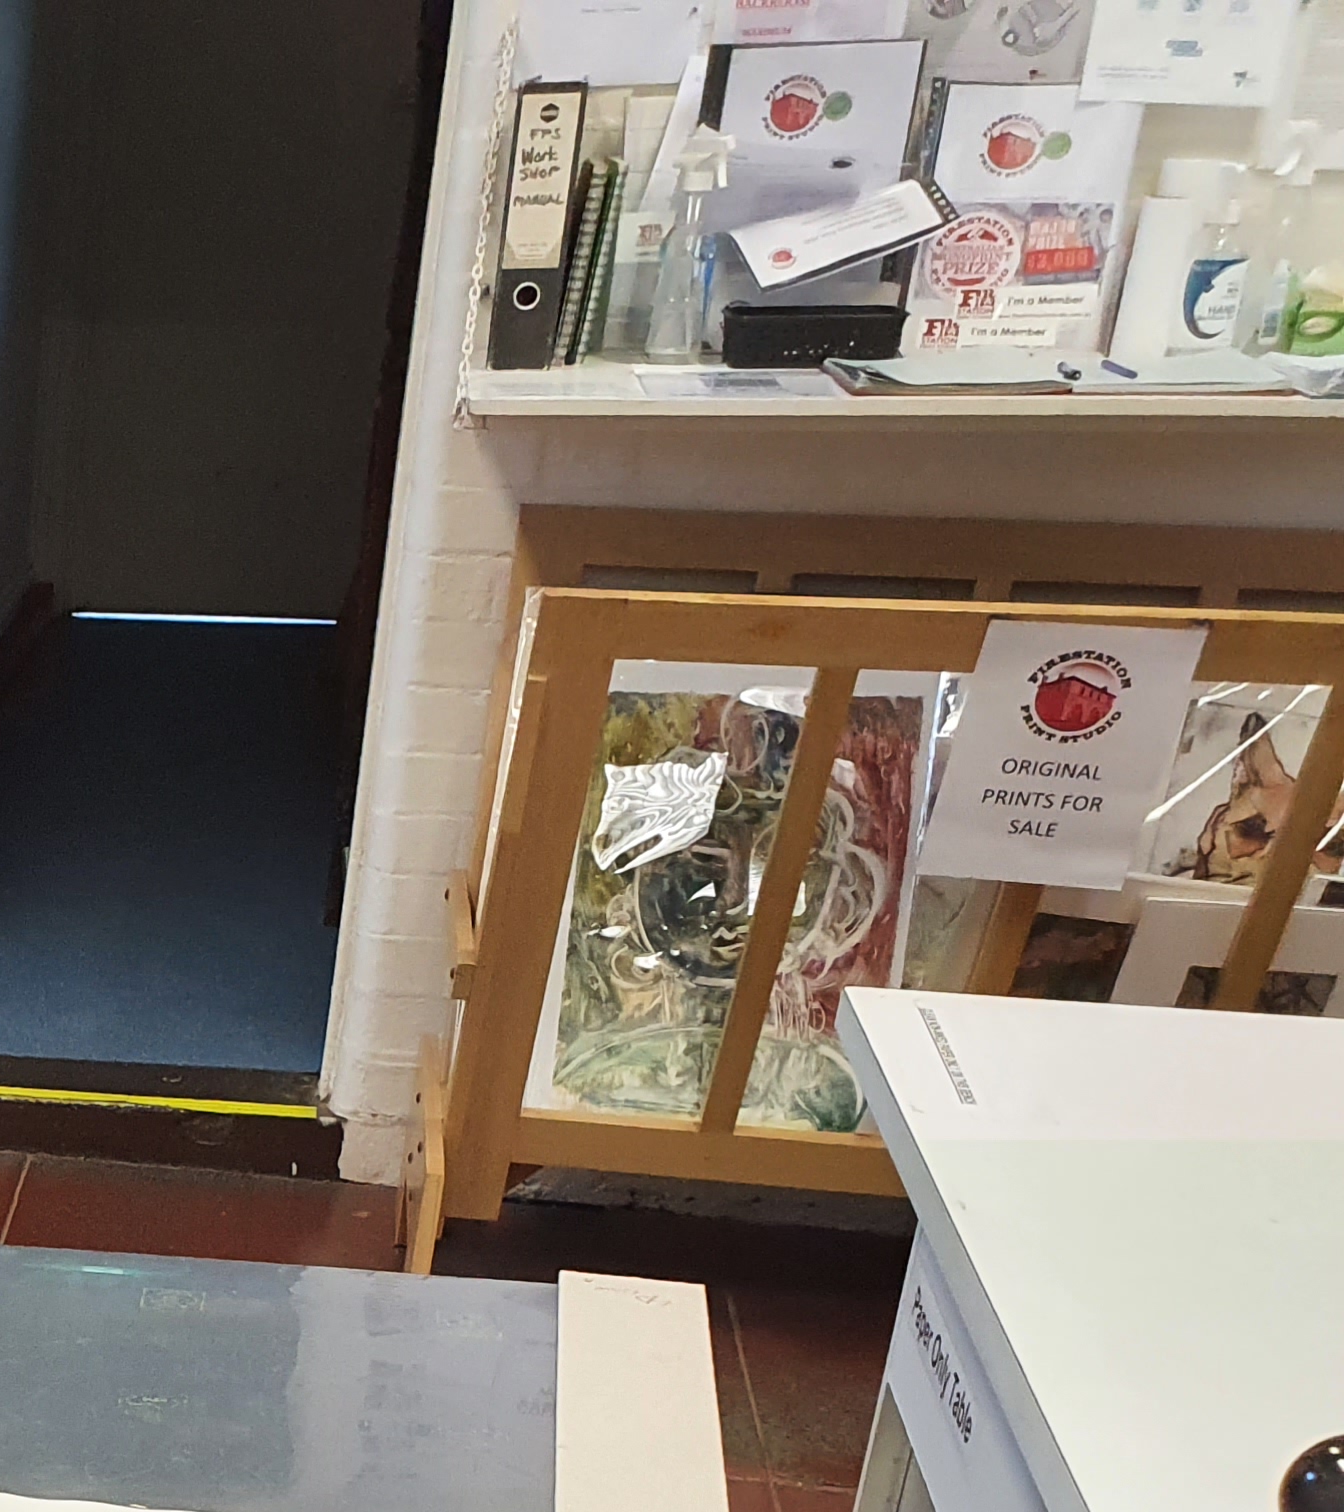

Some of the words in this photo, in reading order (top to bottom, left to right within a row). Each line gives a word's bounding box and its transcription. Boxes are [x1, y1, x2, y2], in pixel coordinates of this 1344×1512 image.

[530, 128, 561, 140] FPS
[942, 261, 1000, 275] PRIZE
[1038, 296, 1084, 305] Member
[1000, 327, 1046, 336] Member
[1027, 650, 1132, 689] FIRESTATION
[1020, 704, 1056, 742] PRINT
[1058, 711, 1122, 744] STUDIO
[1001, 758, 1102, 781] ORIGINAL
[981, 788, 1055, 809] PRINTS
[1060, 794, 1103, 813] FOR
[1007, 819, 1058, 838] SALE
[931, 1334, 951, 1399] Only
[949, 1372, 973, 1443] Table
